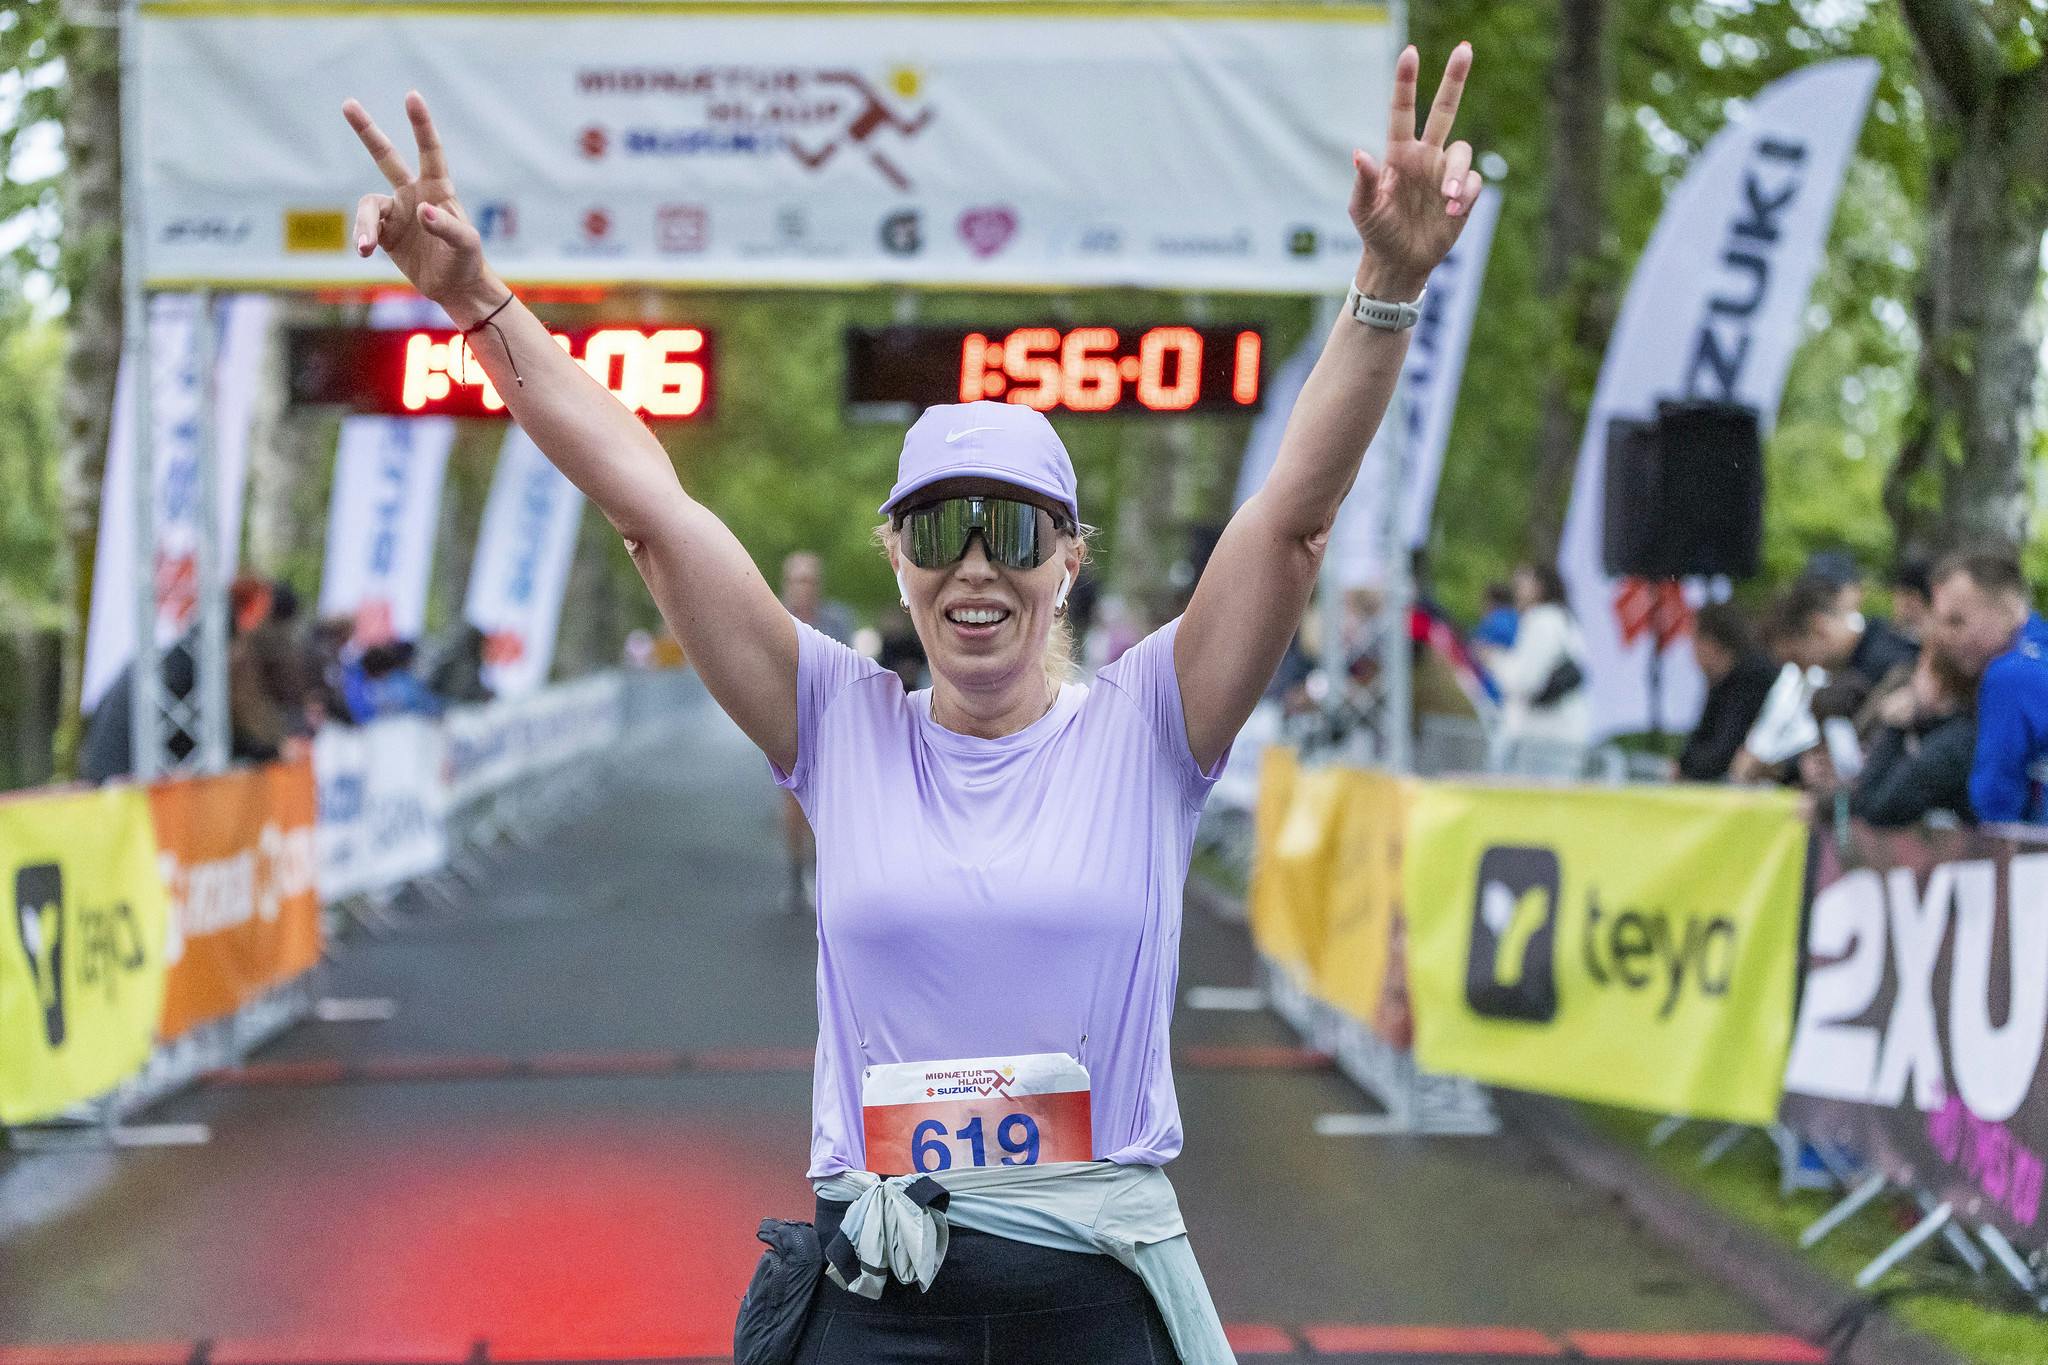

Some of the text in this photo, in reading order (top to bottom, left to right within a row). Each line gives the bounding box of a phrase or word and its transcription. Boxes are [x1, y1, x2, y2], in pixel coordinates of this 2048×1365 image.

[1683, 140, 1807, 398] ZUKI
[1583, 886, 1737, 1026] teya
[1784, 854, 2048, 1122] 2XU
[925, 1069, 983, 1081] MIÐNÆTUR
[937, 1085, 977, 1096] SUZUKI
[958, 1076, 993, 1086] HLAUP
[911, 1113, 1040, 1173] 619
